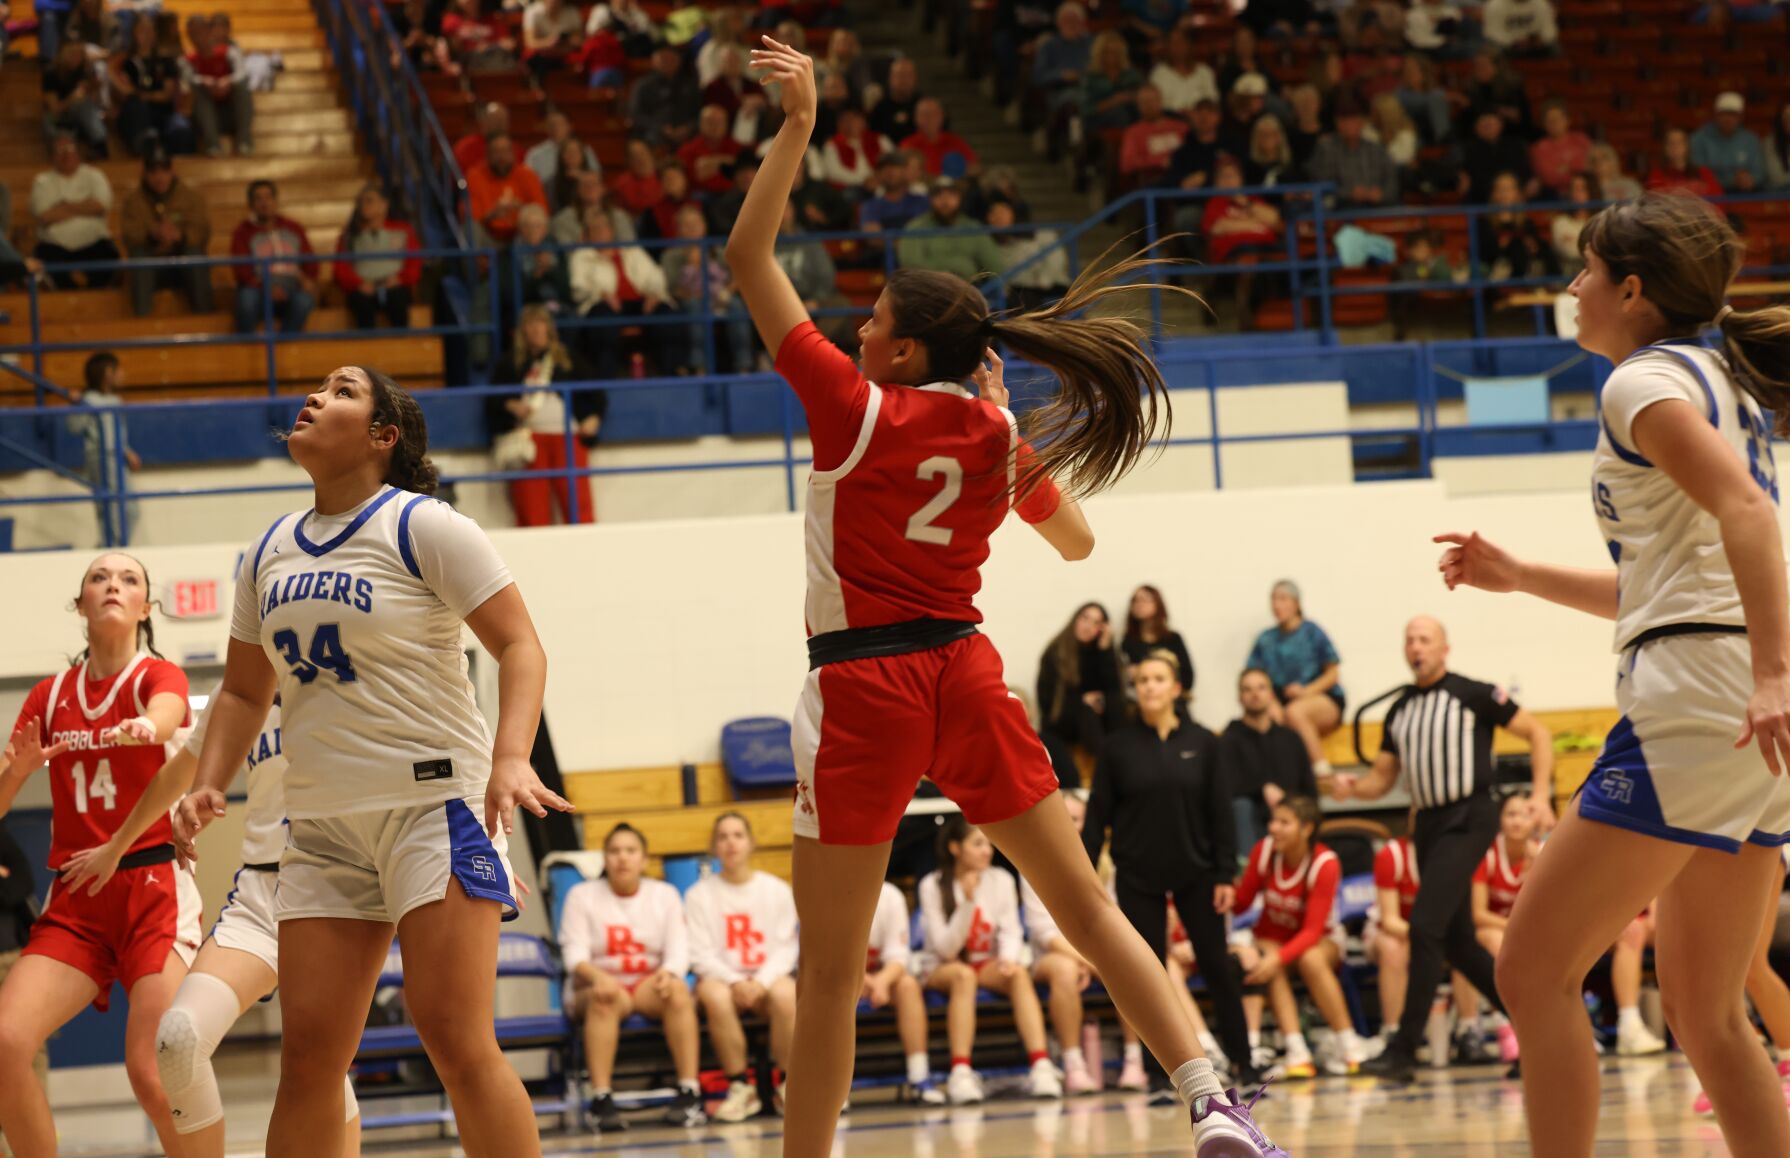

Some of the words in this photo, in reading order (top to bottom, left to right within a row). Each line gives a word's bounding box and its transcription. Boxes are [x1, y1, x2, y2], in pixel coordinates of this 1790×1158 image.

[904, 454, 964, 547] 2
[174, 580, 218, 617] EXIT
[272, 621, 358, 685] 34
[52, 727, 119, 751] COBBLE
[71, 758, 118, 814] 14
[439, 764, 449, 773] XL
[605, 924, 648, 974] RC
[725, 913, 768, 967] RC
